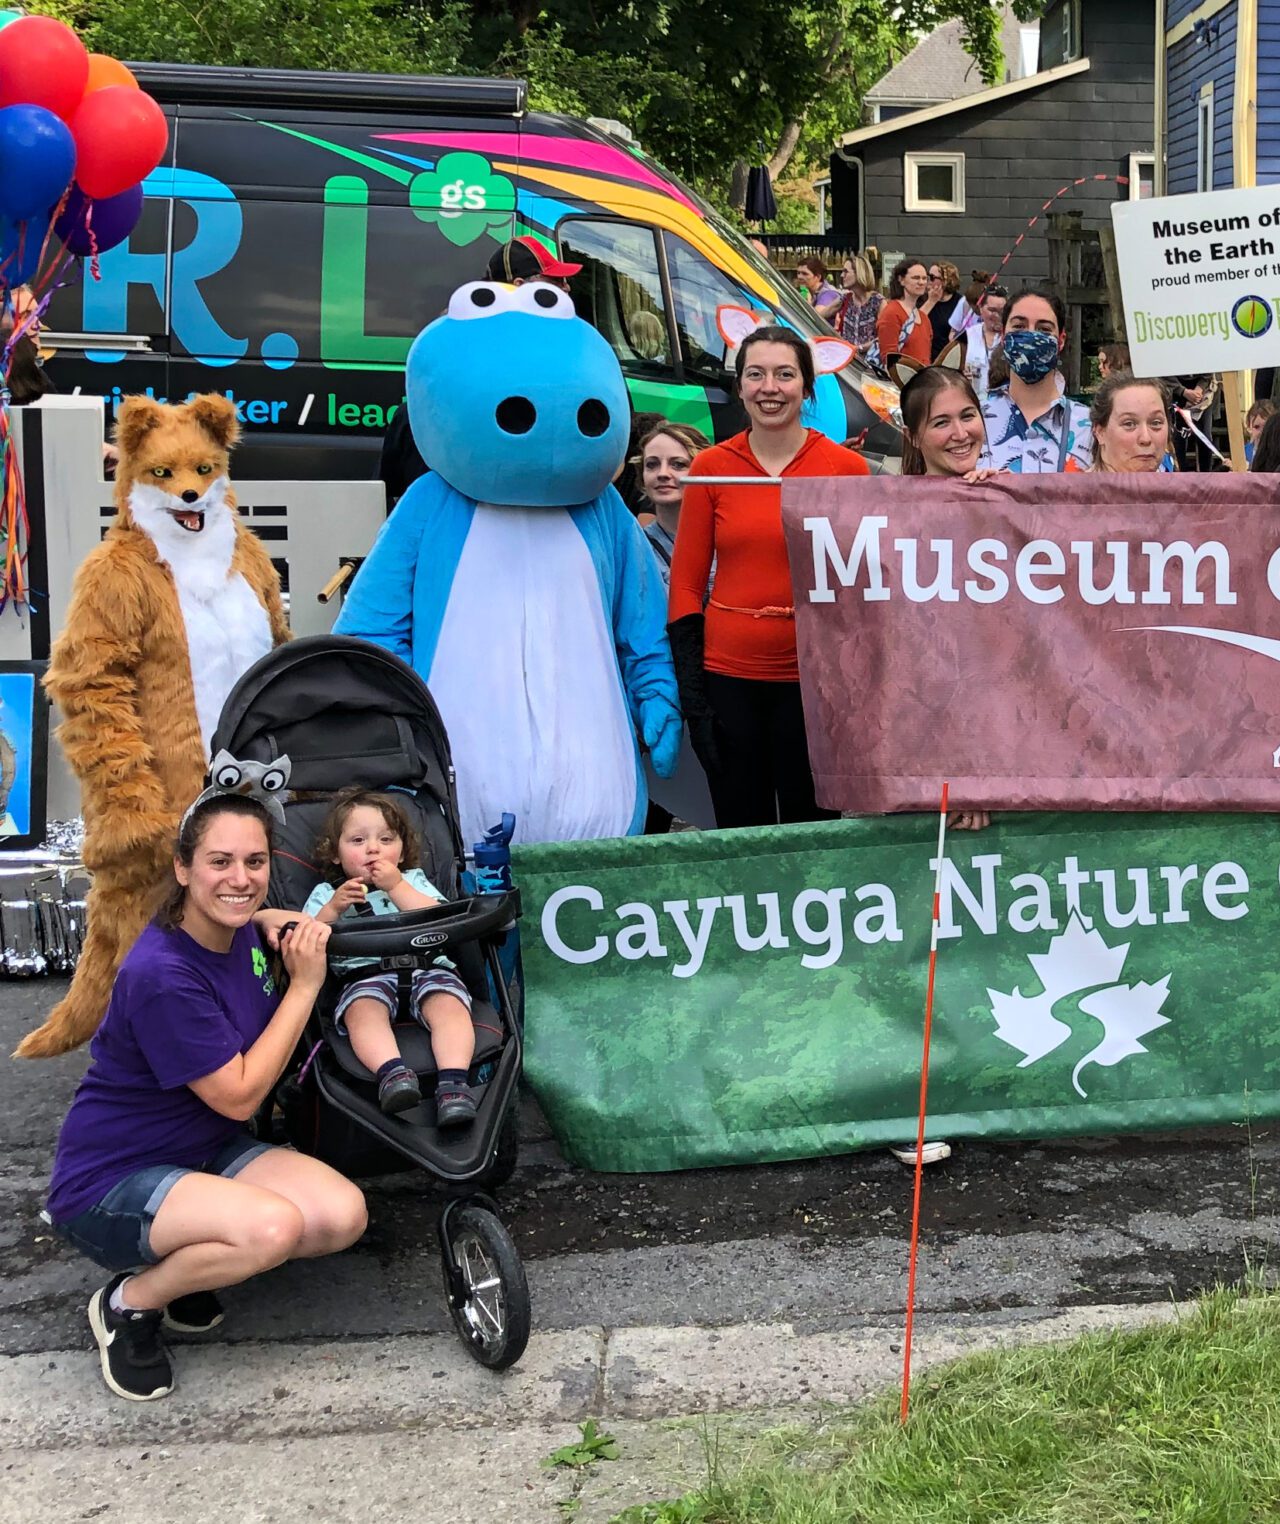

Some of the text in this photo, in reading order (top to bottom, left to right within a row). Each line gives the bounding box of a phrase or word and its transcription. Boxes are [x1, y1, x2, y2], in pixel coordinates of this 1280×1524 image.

[440, 179, 487, 219] gs
[1152, 207, 1280, 238] Museum of
[1164, 237, 1275, 265] the Earth
[1151, 272, 1191, 290] proud
[1194, 262, 1250, 283] member
[1254, 265, 1269, 277] of
[1134, 310, 1231, 343] Discovery
[803, 515, 1237, 606] Museum
[540, 883, 903, 979] Cayuga
[928, 853, 1250, 940] Nature
